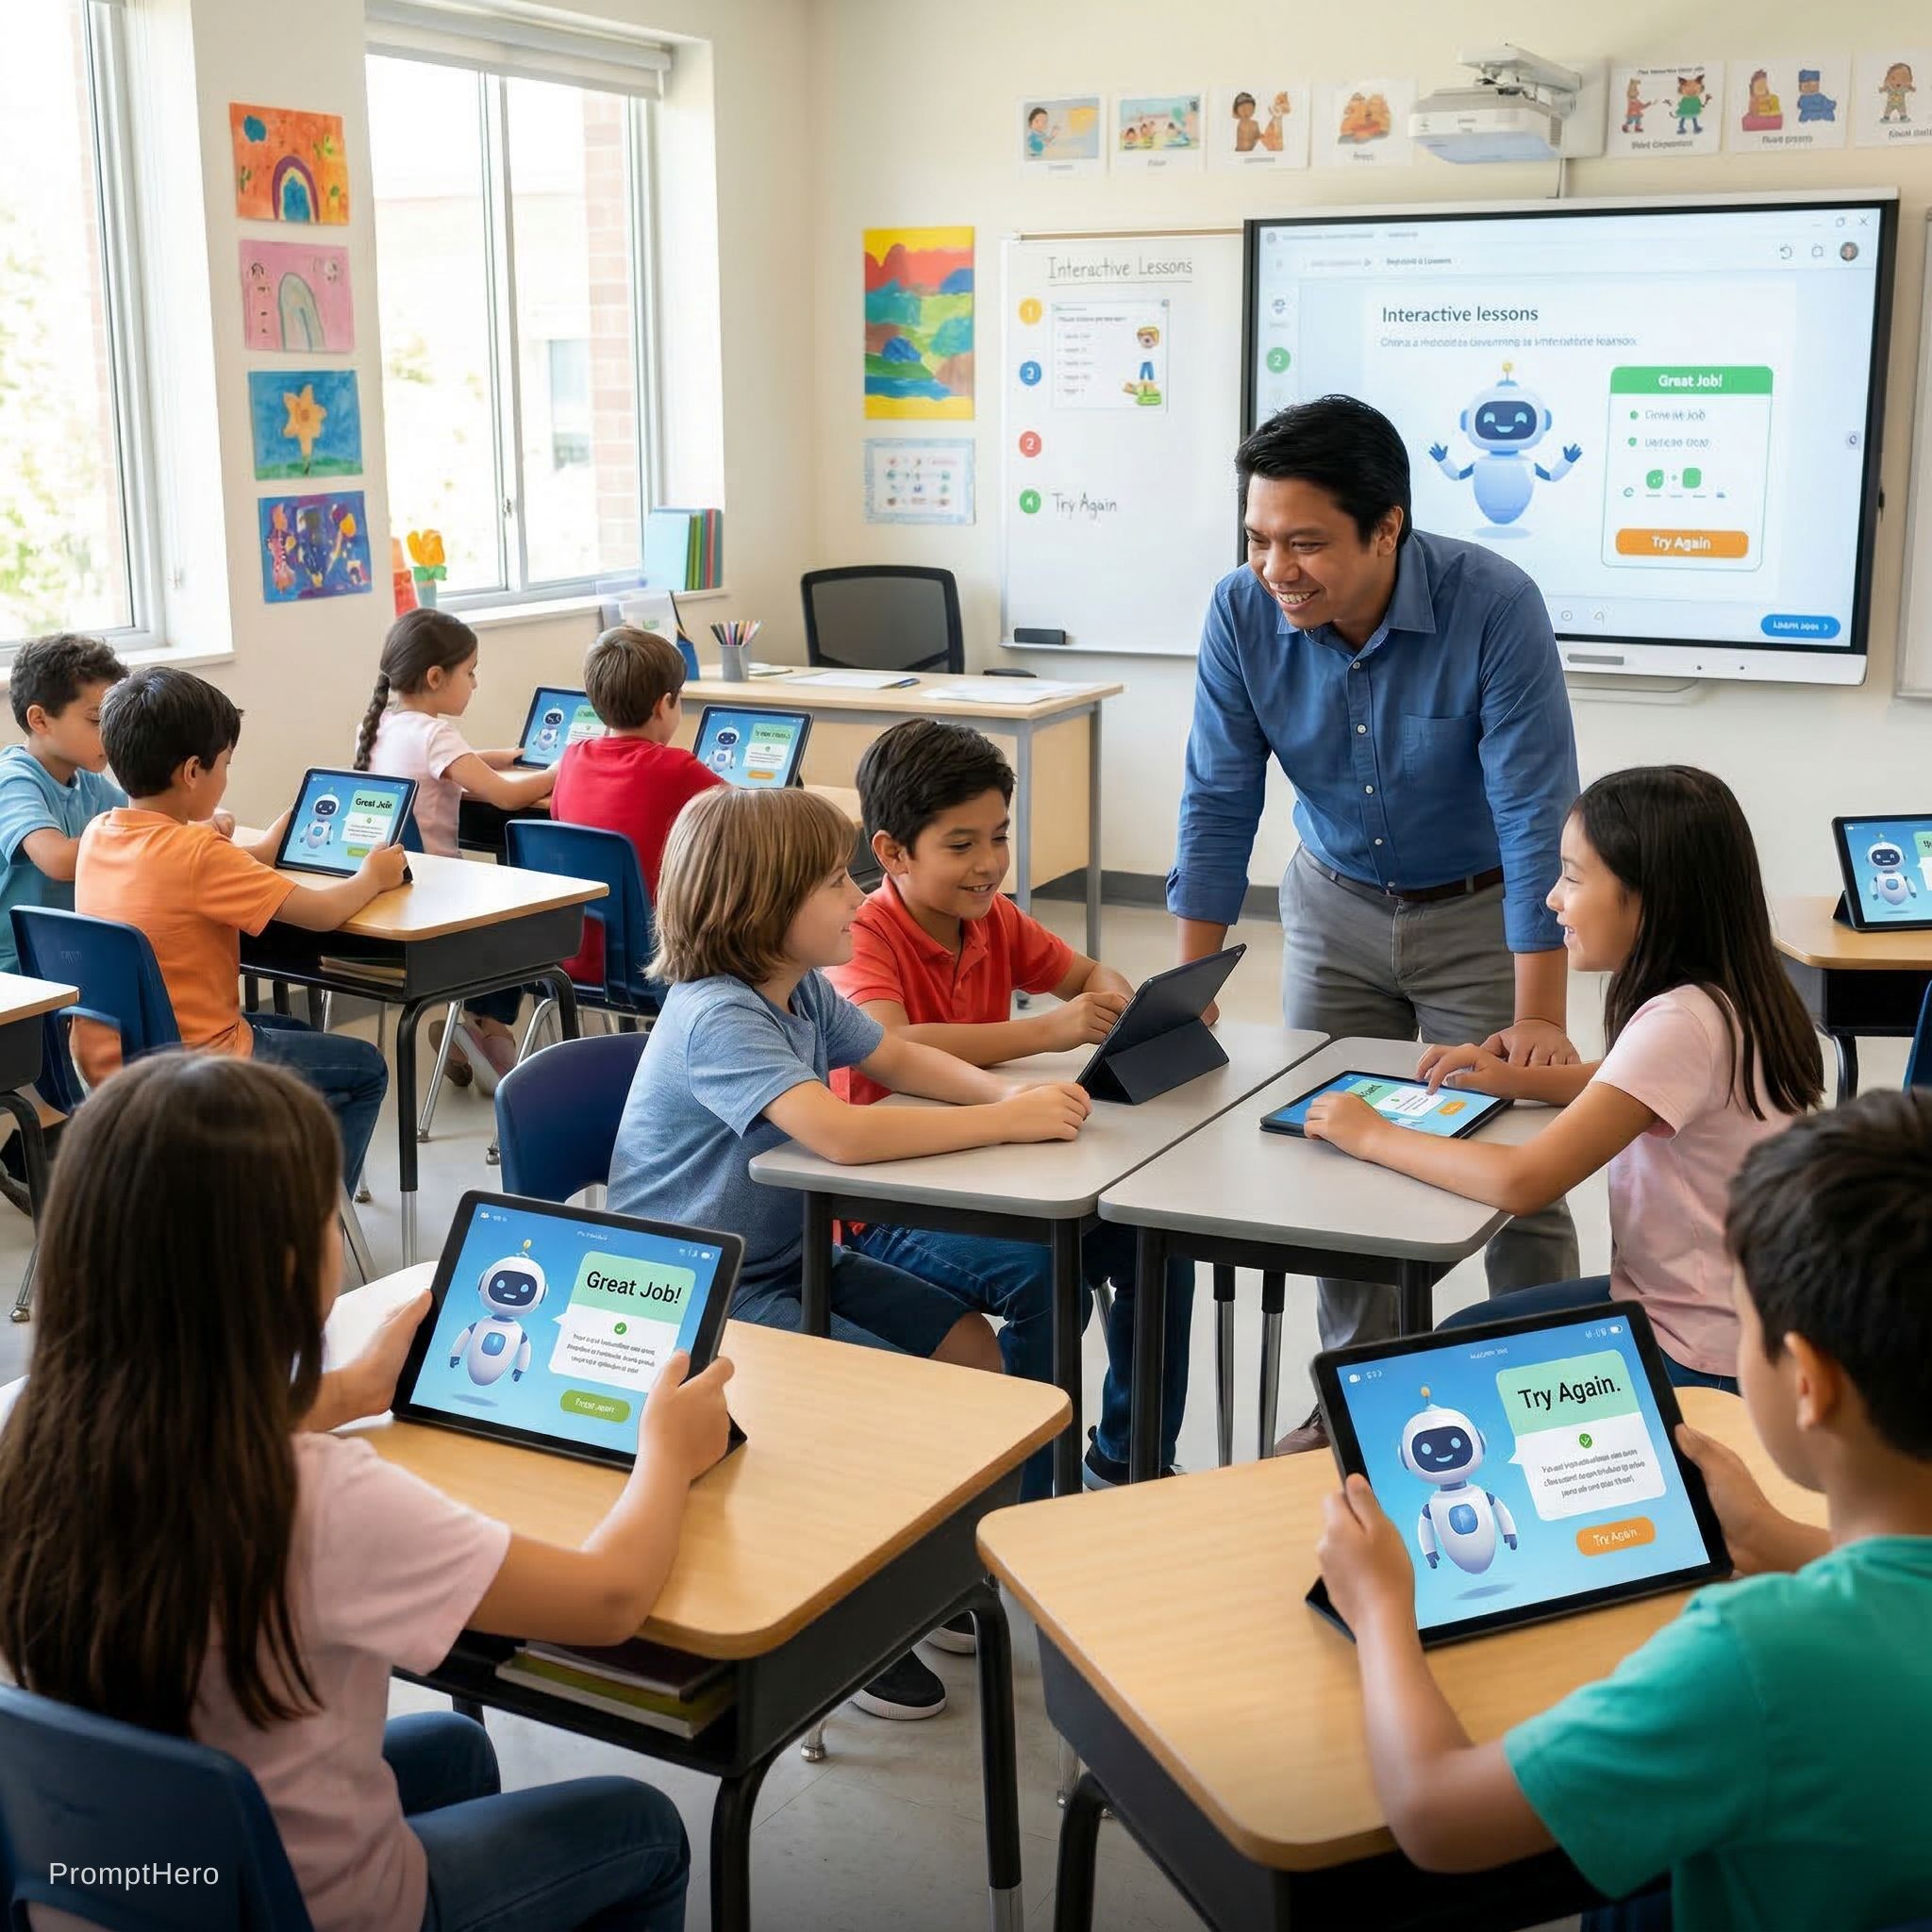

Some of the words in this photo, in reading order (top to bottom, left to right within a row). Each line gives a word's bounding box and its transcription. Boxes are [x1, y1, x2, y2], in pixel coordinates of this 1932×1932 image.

[1049, 257, 1130, 279] Interactive
[1139, 256, 1192, 275] Lessons
[1382, 306, 1472, 323] Interactive
[1476, 306, 1539, 322] lessons
[1658, 375, 1694, 388] Great
[1697, 375, 1723, 388] Job!
[1052, 492, 1075, 518] Try
[1079, 492, 1117, 518] Again
[1652, 536, 1672, 550] Try
[1674, 536, 1711, 551] Again
[587, 1271, 637, 1296] Great
[640, 1281, 682, 1305] Job!
[1517, 1389, 1552, 1411] Try
[1558, 1374, 1622, 1405] Again.
